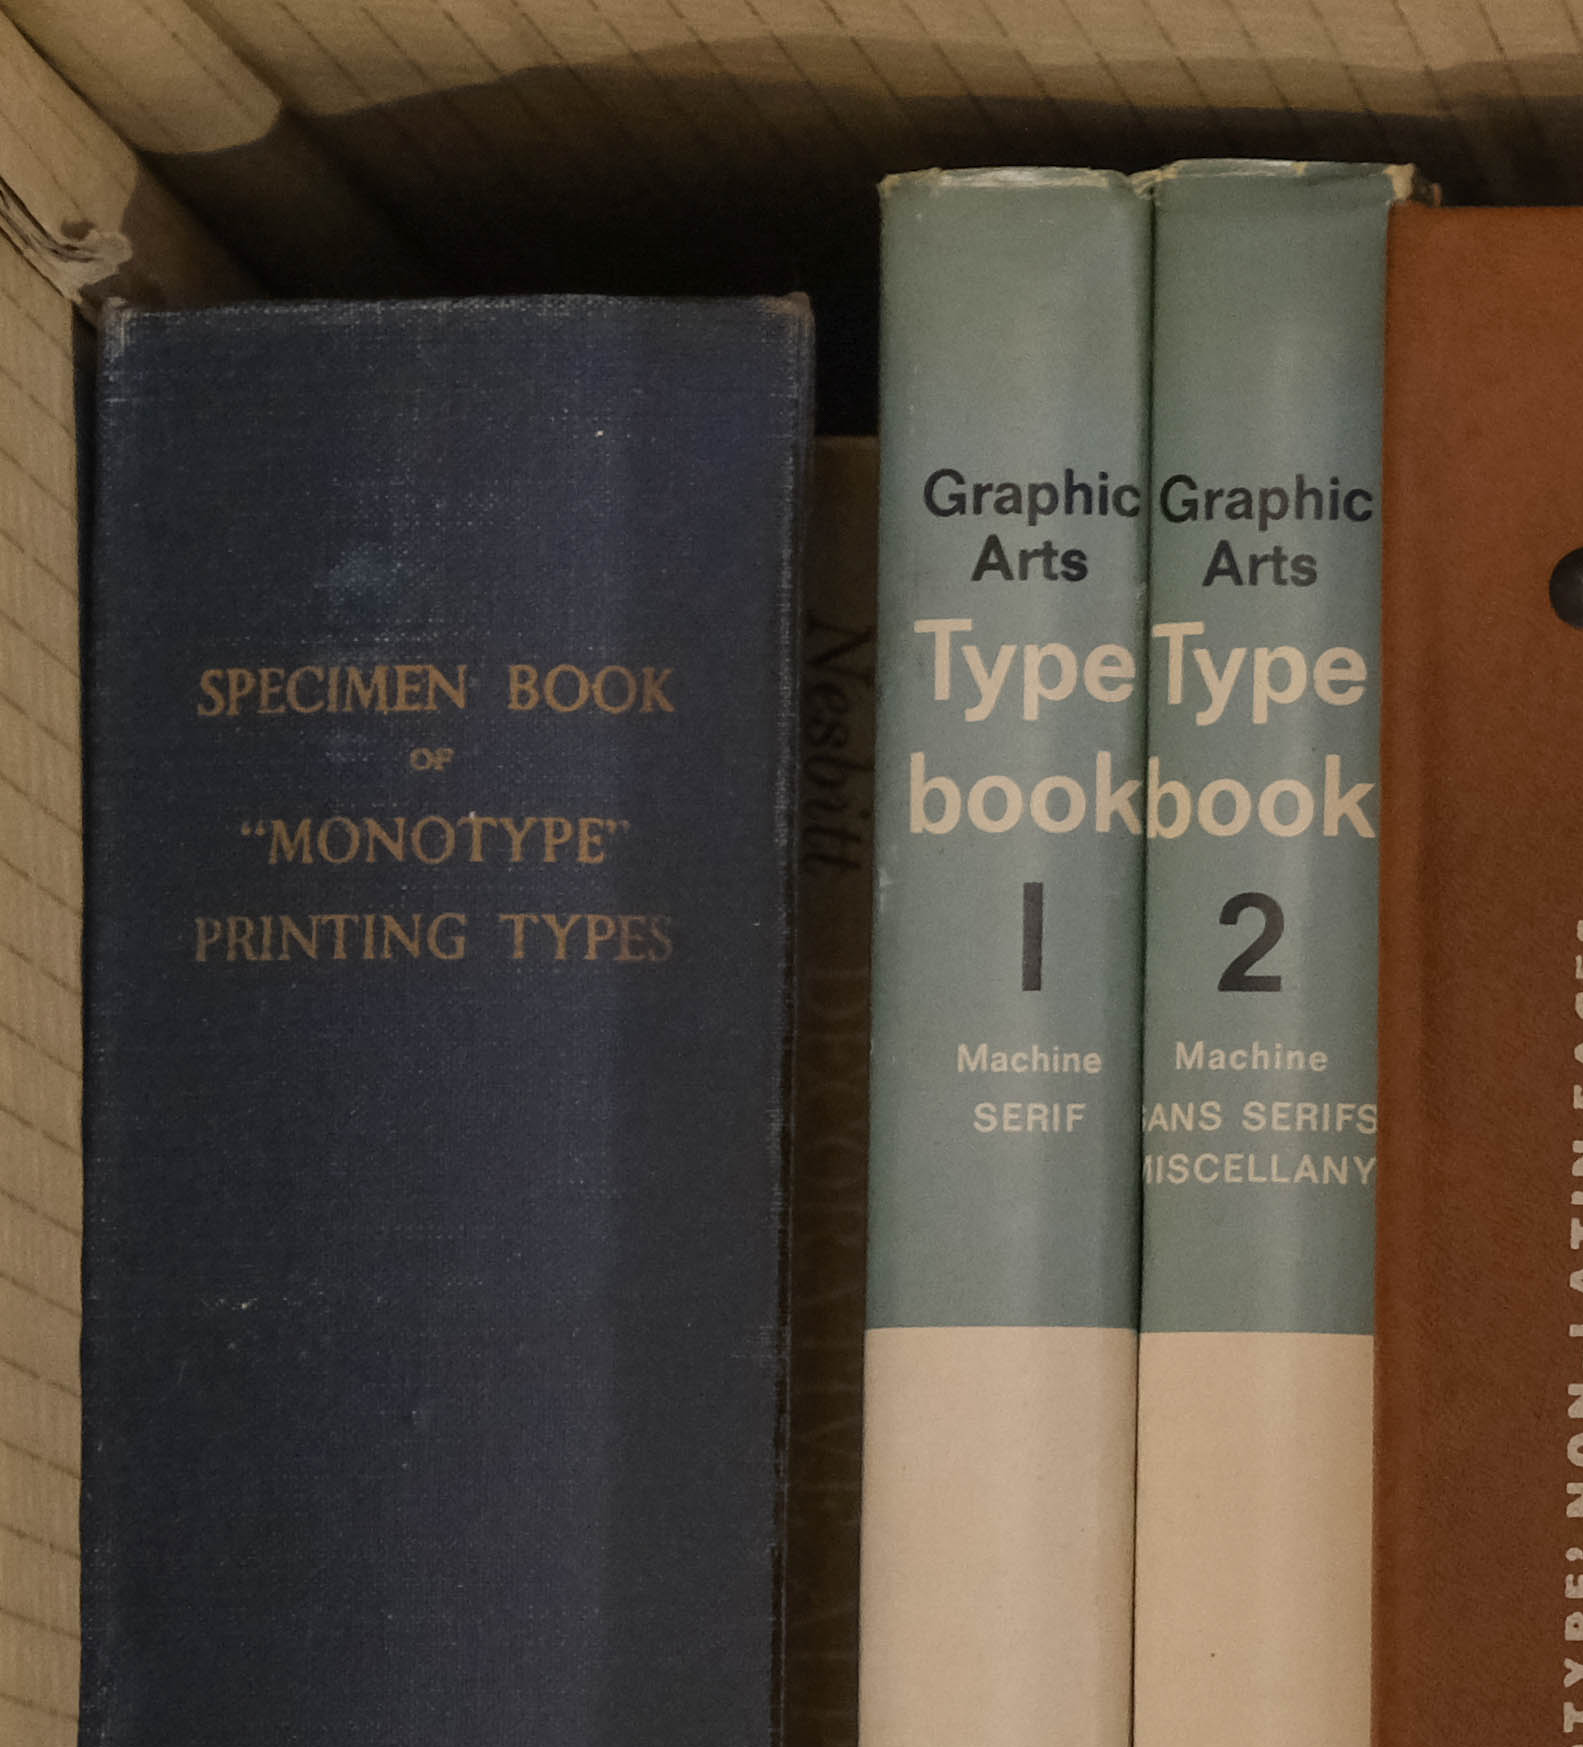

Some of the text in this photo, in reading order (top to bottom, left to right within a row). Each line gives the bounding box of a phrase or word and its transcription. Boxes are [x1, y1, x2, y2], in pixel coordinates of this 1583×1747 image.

[924, 468, 1142, 527] Graphic
[1159, 474, 1374, 532] Graphic
[971, 534, 1088, 582] Arts
[1202, 539, 1318, 587] Arts
[197, 664, 677, 716] SPECIMEN BOOK
[914, 618, 1137, 722] Type
[1152, 621, 1367, 726] Type
[408, 746, 455, 772] OF
[908, 750, 1143, 835] book
[1147, 753, 1377, 840] book
[195, 914, 673, 962] PRINTING TYPES
[1217, 891, 1285, 993] 2
[956, 1044, 1103, 1074] Machine
[1175, 1041, 1329, 1072] Machine
[973, 1102, 1087, 1134] SERIF
[1143, 1100, 1378, 1135] ANS SERIFS
